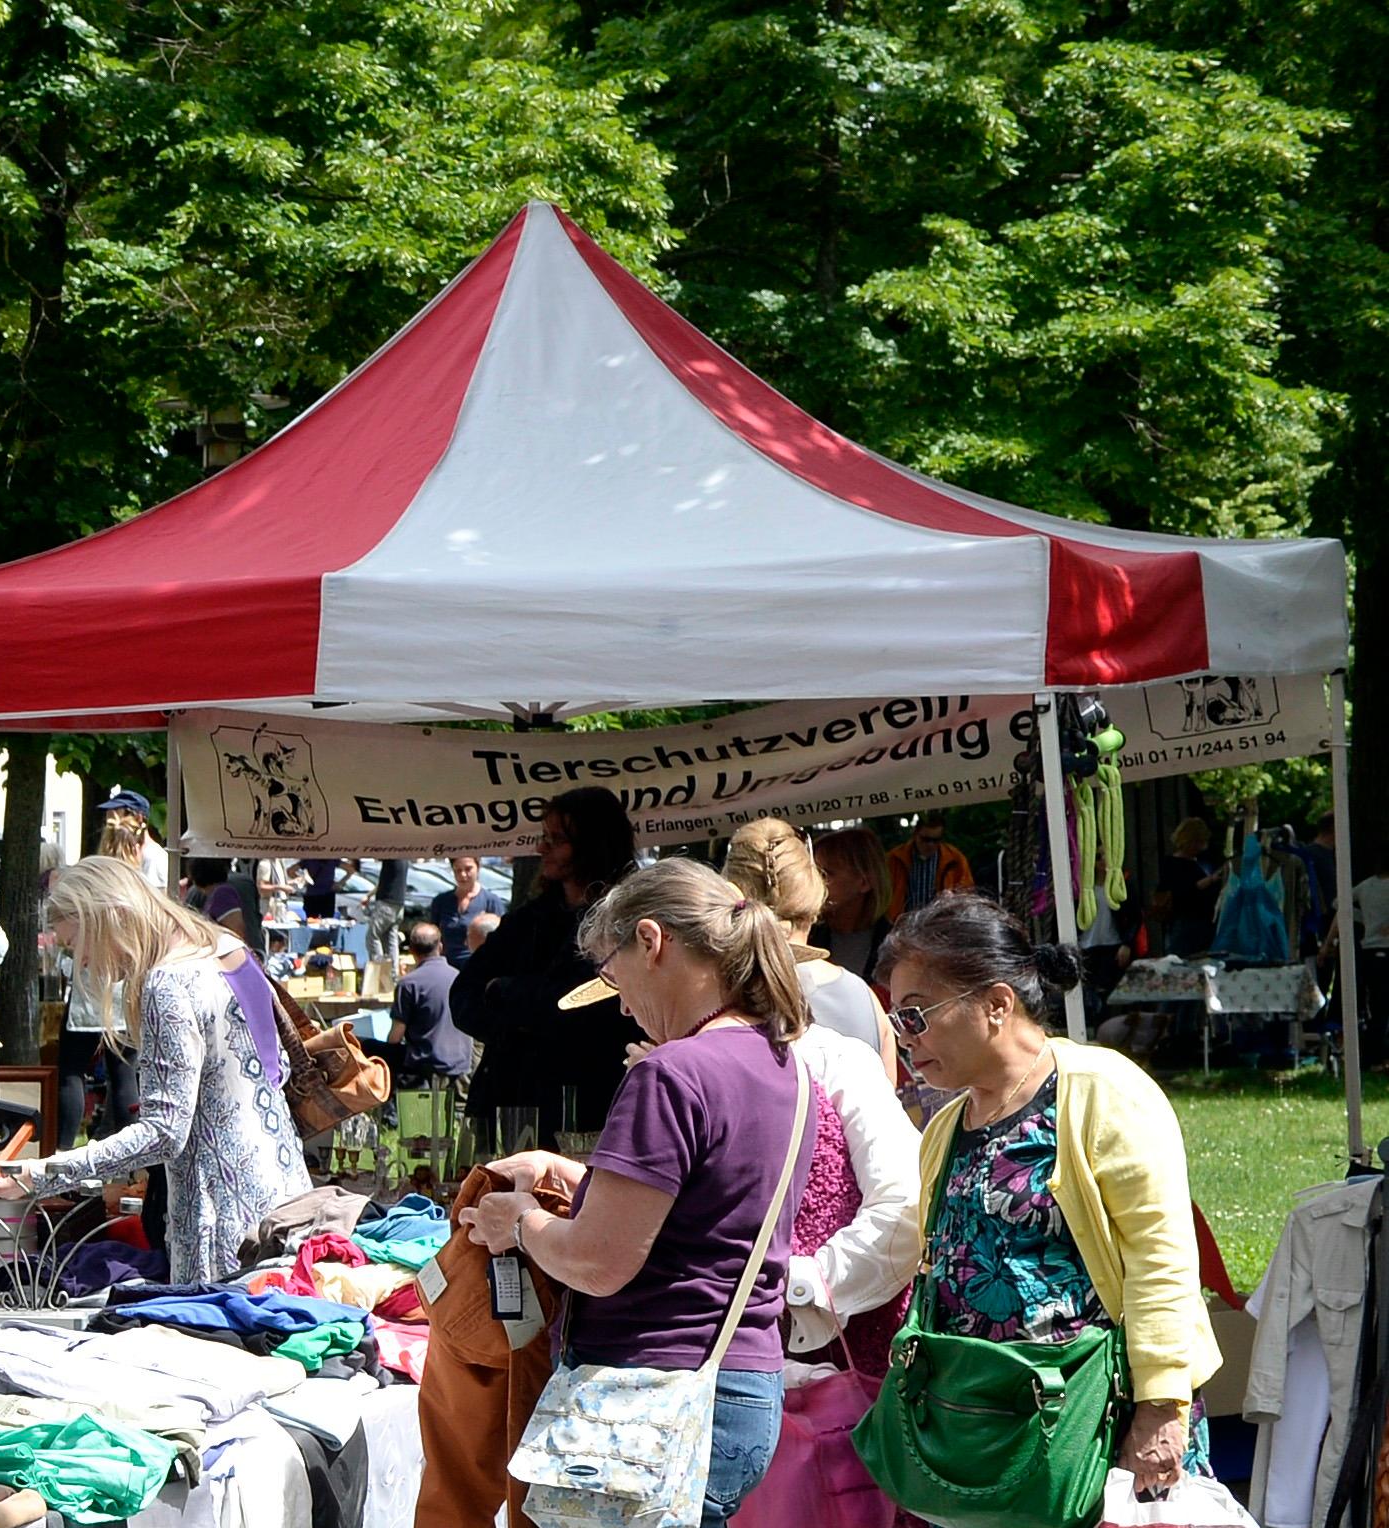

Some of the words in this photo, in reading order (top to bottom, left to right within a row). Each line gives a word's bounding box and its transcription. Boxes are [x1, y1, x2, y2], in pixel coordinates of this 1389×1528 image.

[353, 795, 545, 833] Erlange
[713, 718, 990, 800] Umgebung
[472, 694, 969, 786] Tierschutzverein
[1148, 749, 1168, 764] 01
[1174, 739, 1233, 760] 71/244
[1238, 735, 1259, 750] 51
[1264, 730, 1286, 745] 94
[645, 814, 714, 834] Erlangen
[725, 810, 753, 824] Tel.
[758, 808, 768, 820] 0
[771, 804, 790, 818] 91
[795, 798, 842, 816] 31/20
[844, 794, 864, 809] 77
[869, 791, 890, 805] 88
[903, 785, 935, 800] Fax
[938, 783, 949, 796] 0
[952, 779, 973, 793] 91
[978, 773, 1004, 789] 31/
